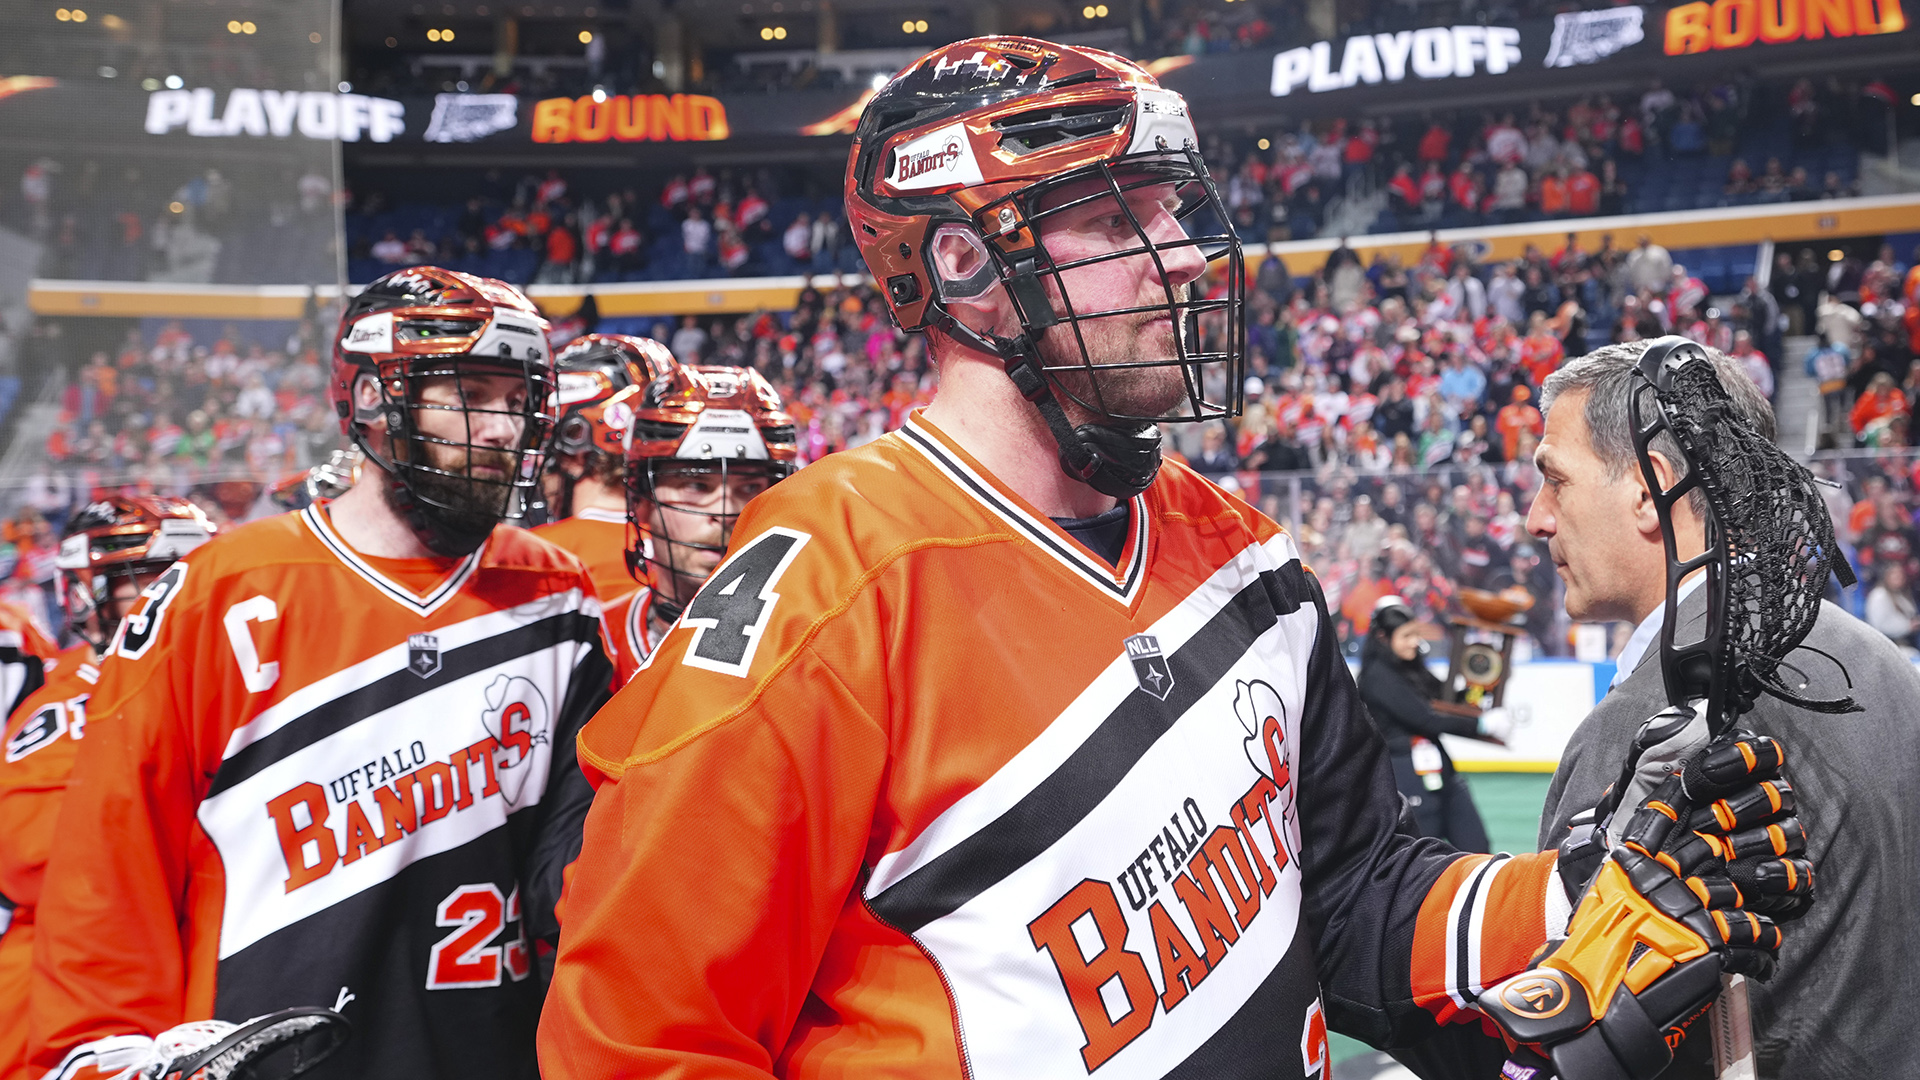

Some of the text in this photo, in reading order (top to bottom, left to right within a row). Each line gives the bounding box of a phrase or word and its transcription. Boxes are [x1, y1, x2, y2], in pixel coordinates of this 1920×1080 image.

[1270, 0, 1904, 97] PLAYOFF ROUND
[145, 88, 729, 143] PLAYOFF ROUND
[898, 143, 958, 183] BANDITS
[223, 595, 280, 693] C
[410, 634, 438, 648] NLL
[1127, 637, 1160, 656] NLL
[266, 702, 532, 894] BANDITS
[1026, 716, 1294, 1075] BANDITS
